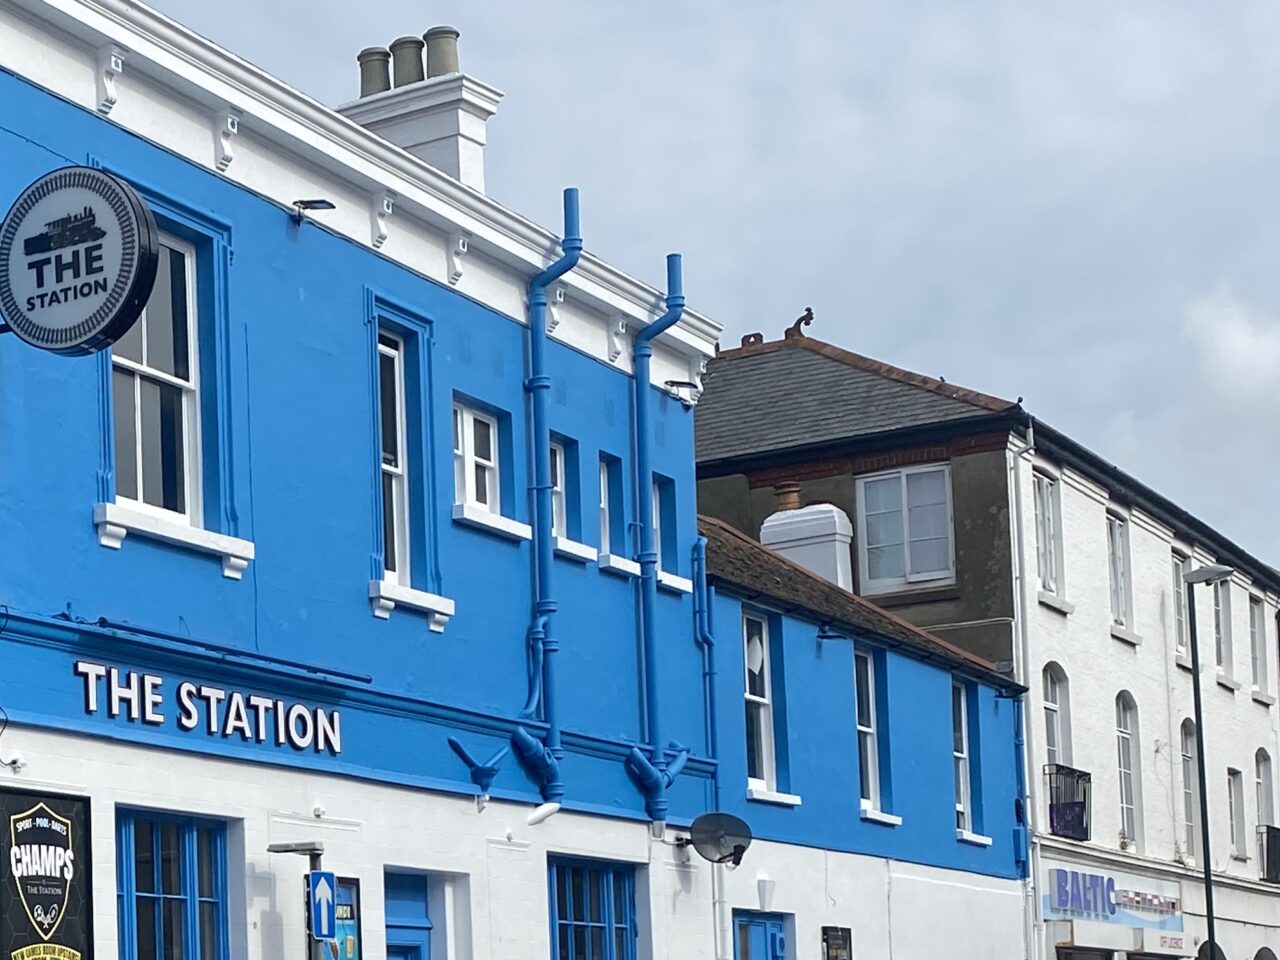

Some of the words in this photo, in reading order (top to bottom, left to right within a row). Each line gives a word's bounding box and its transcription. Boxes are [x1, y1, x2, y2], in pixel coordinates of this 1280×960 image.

[27, 243, 104, 289] THE
[26, 277, 108, 312] STATION
[75, 660, 165, 724] THE
[177, 680, 342, 754] STATION
[16, 819, 32, 832] SPORT
[36, 818, 48, 828] POOL
[51, 820, 67, 835] DARTS
[10, 844, 74, 880] CHAMPS
[1055, 868, 1117, 916] BALTIC
